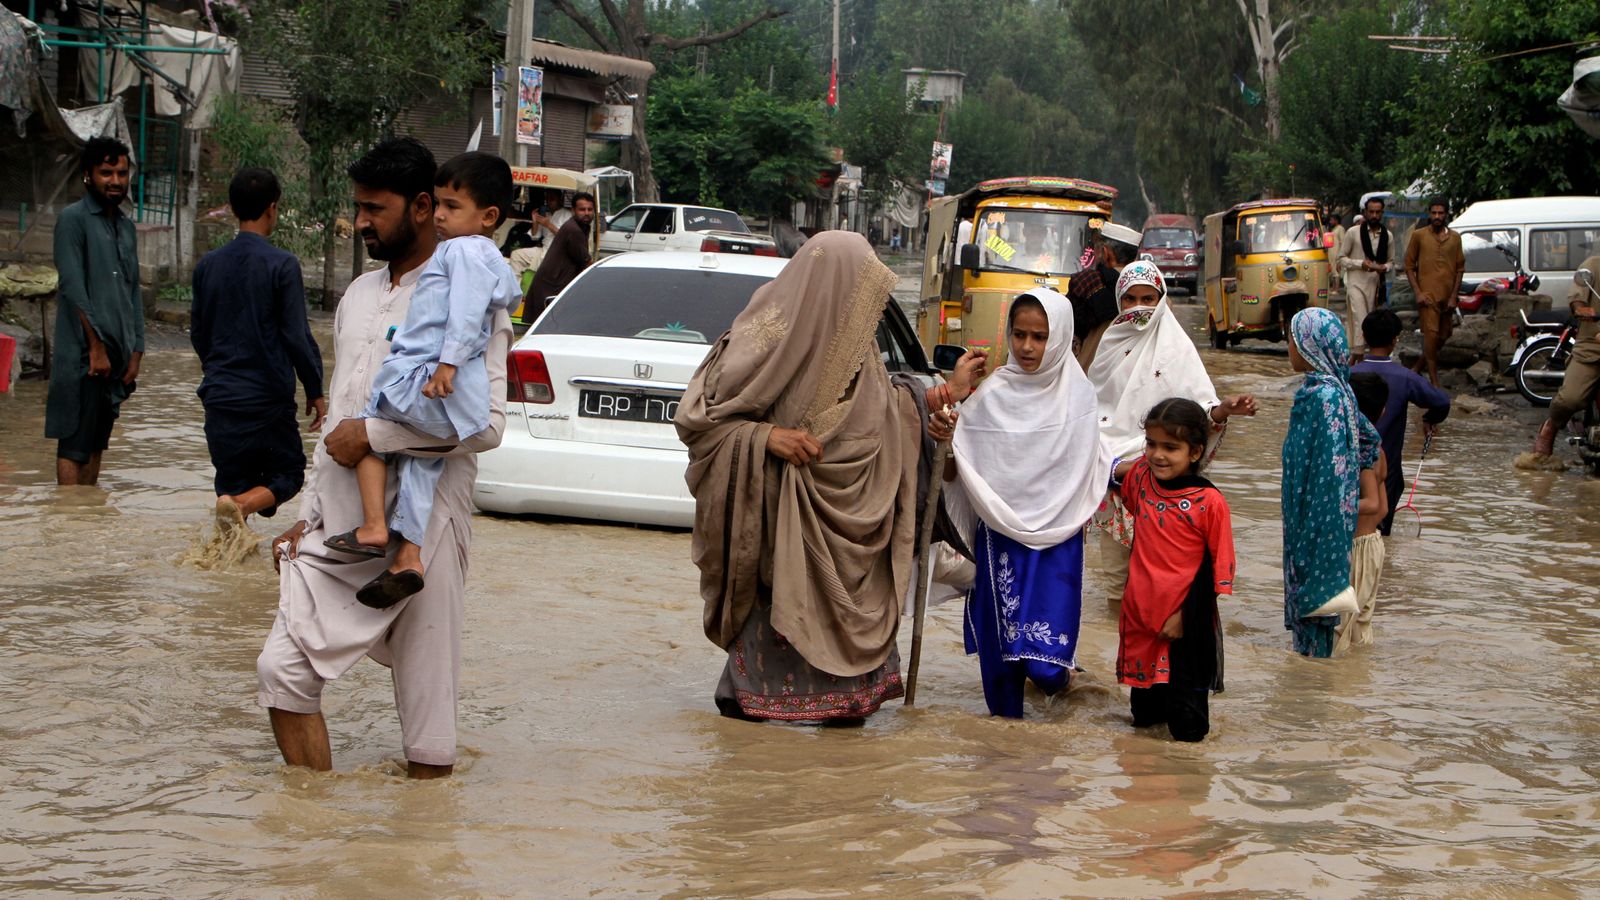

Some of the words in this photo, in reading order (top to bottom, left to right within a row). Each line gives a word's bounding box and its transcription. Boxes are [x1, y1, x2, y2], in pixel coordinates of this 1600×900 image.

[512, 171, 549, 184] RAFTAR
[984, 234, 1017, 262] ANMOL
[584, 393, 630, 417] LRP
